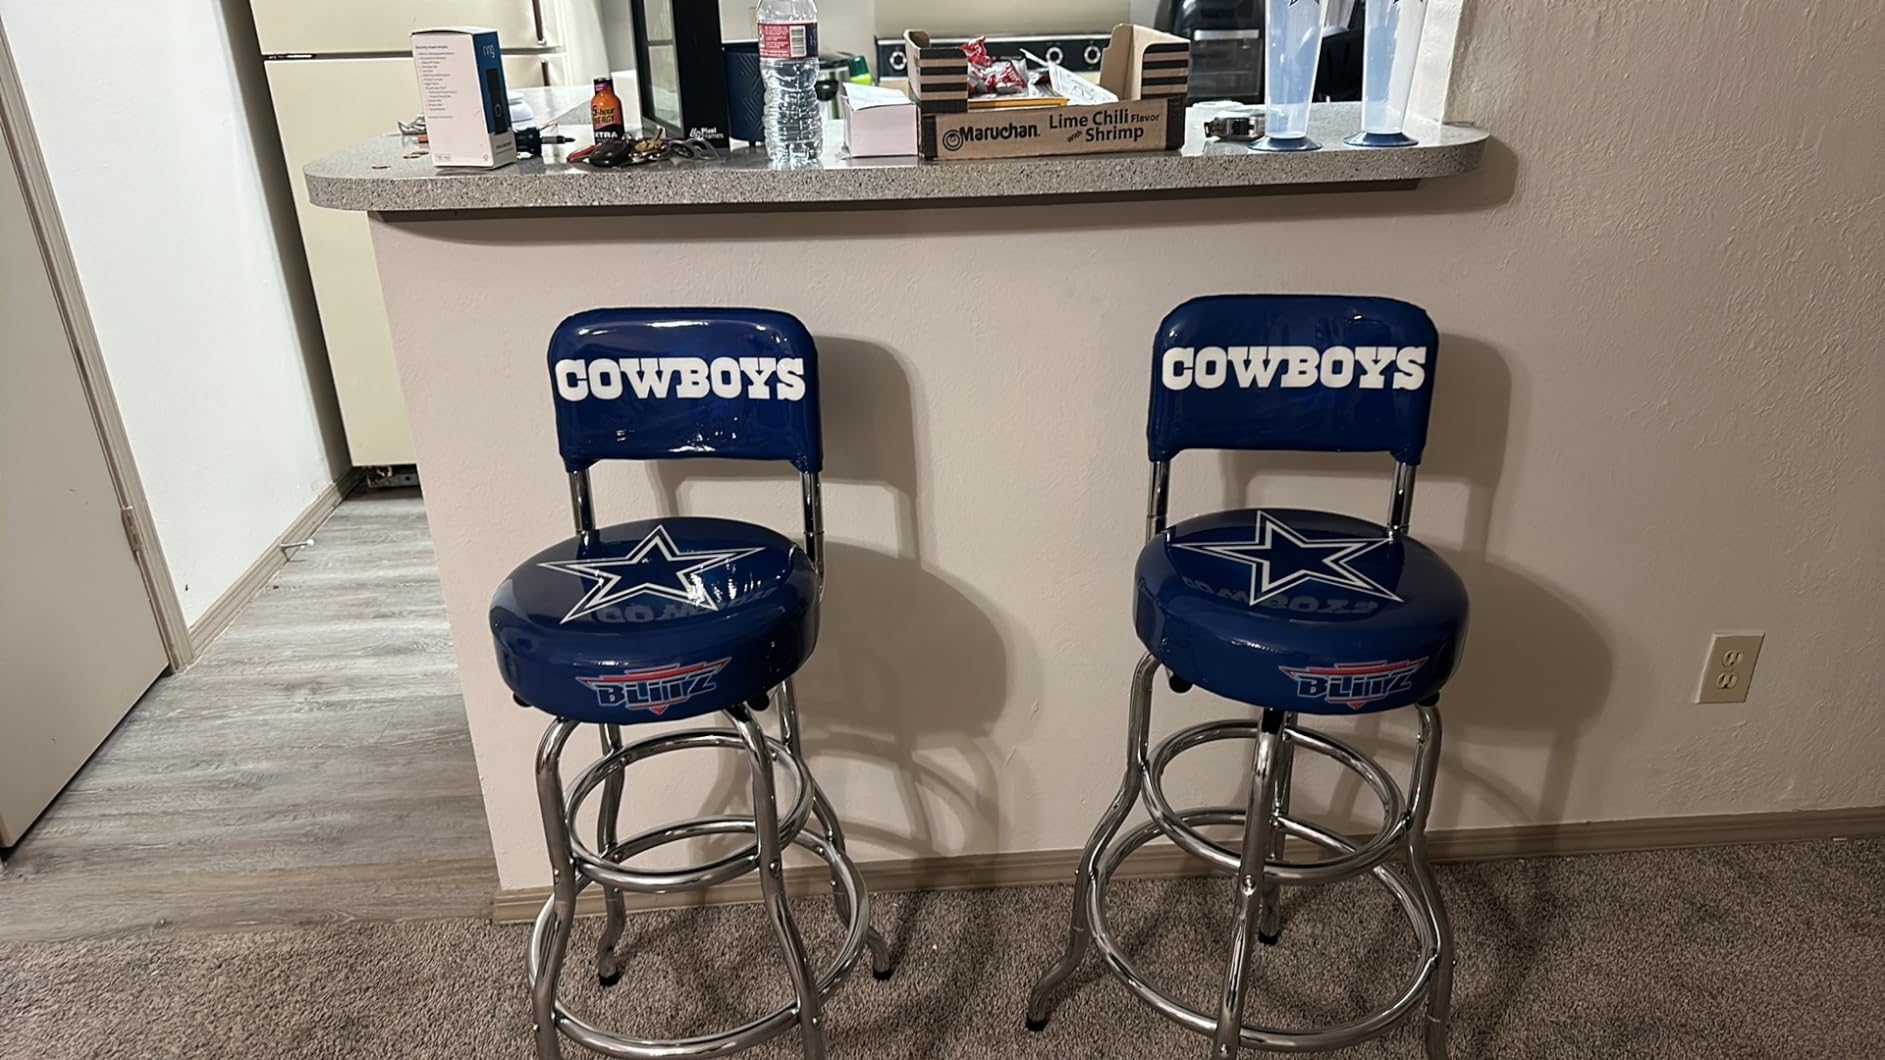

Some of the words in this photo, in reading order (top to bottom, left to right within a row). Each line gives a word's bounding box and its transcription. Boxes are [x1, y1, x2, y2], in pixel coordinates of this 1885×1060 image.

[1049, 113, 1089, 130] Lime
[1092, 108, 1129, 126] Chili
[1130, 112, 1160, 124] Flavor
[594, 131, 618, 139] XTRA
[959, 121, 1038, 142] Maruchan
[1066, 129, 1083, 143] with
[1085, 124, 1145, 143] Shrimp
[1161, 345, 1428, 391] COWBOYS
[555, 357, 807, 402] COWBOYS
